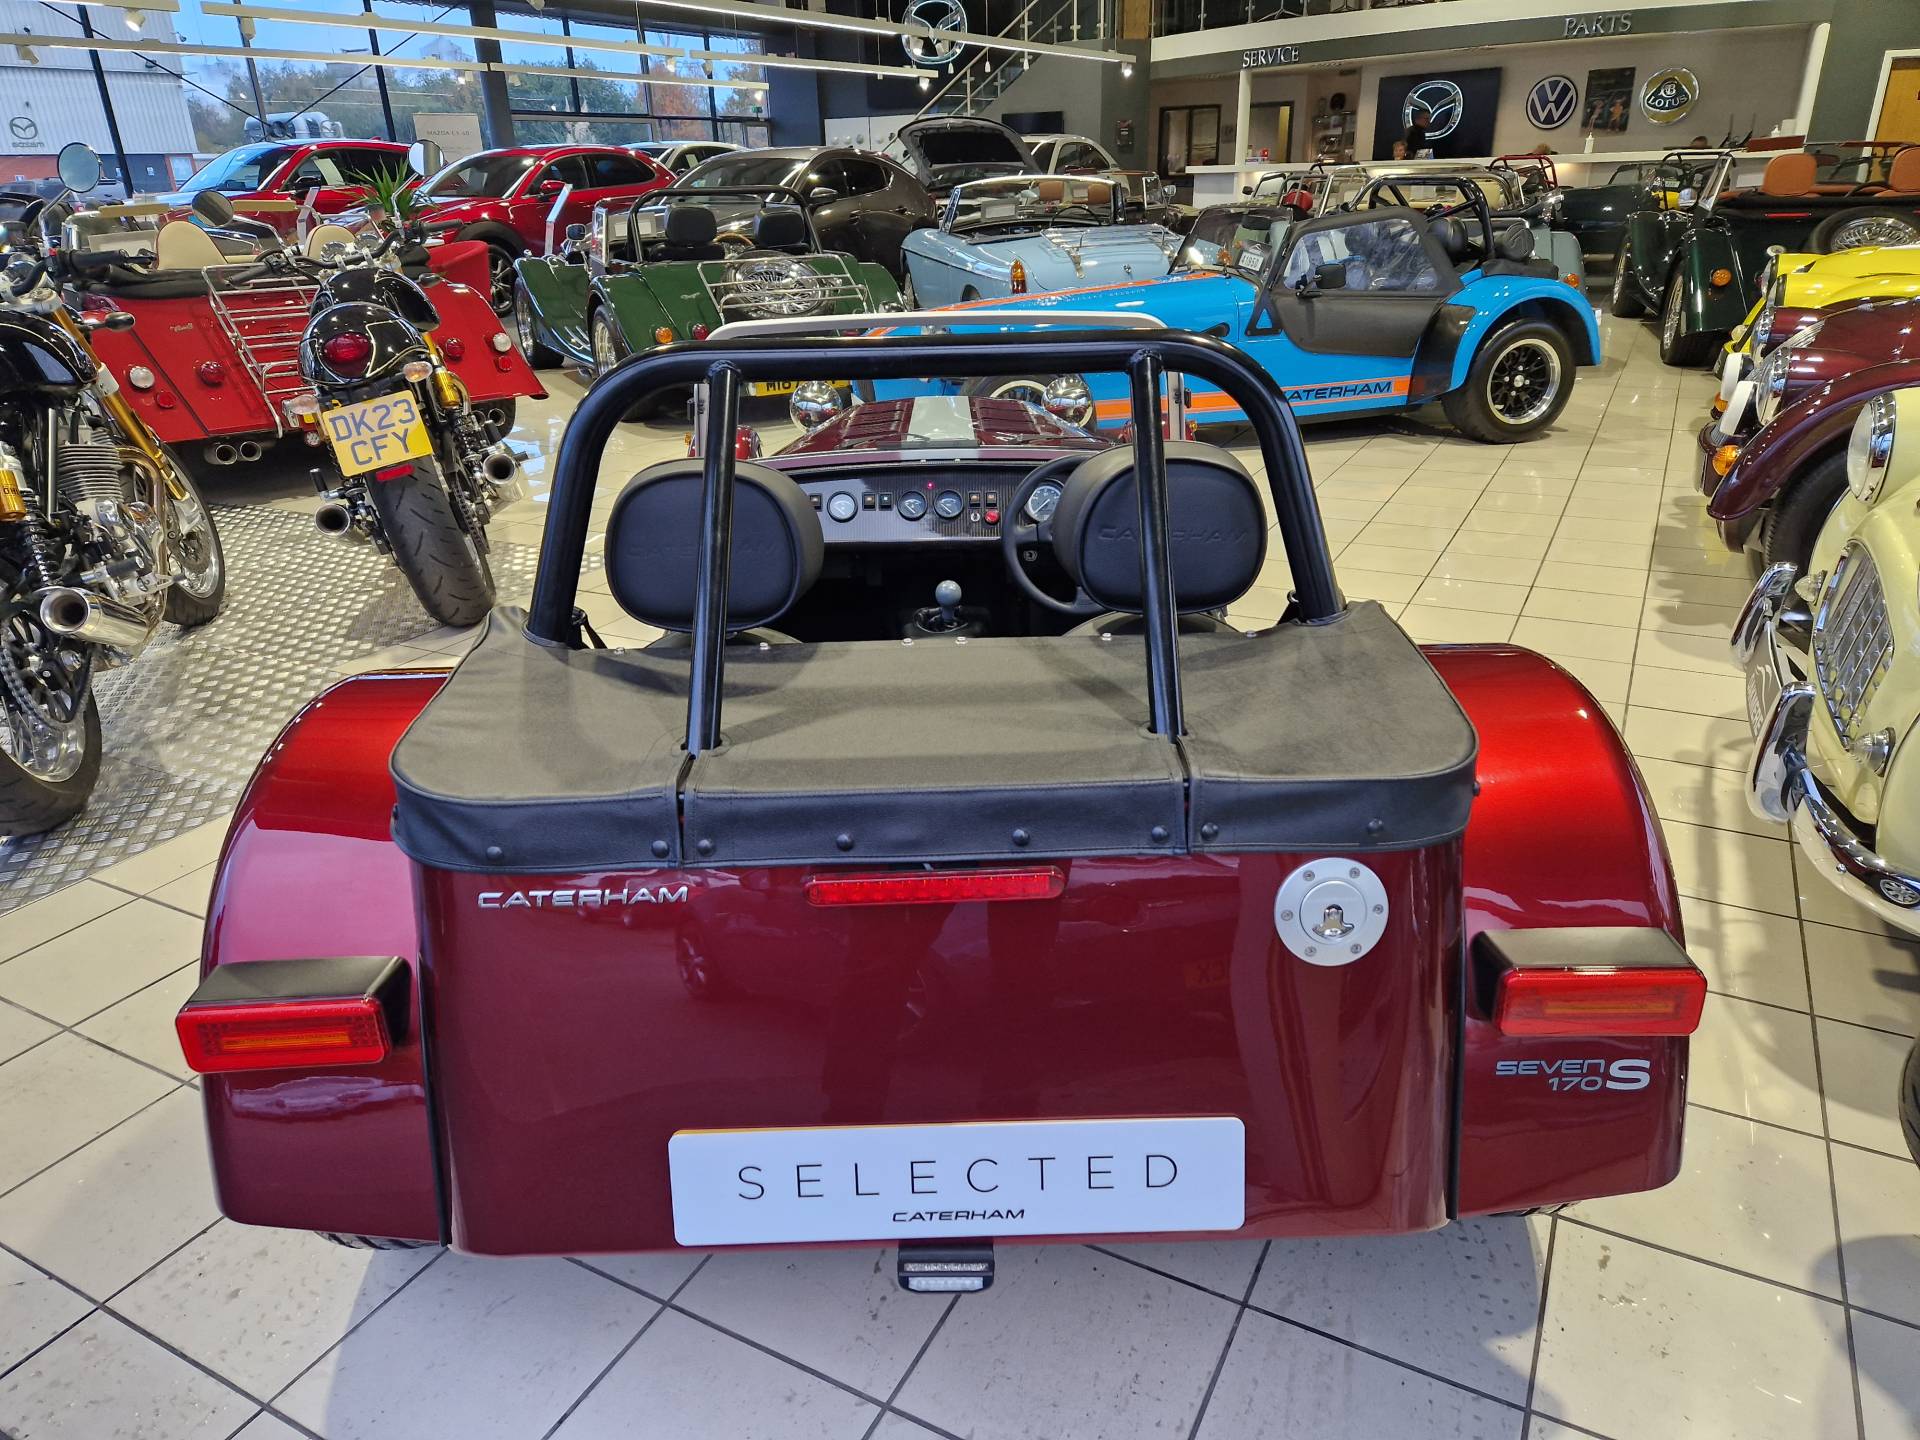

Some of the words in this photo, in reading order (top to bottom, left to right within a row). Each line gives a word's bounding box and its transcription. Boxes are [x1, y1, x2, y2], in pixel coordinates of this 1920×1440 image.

[1563, 12, 1632, 36] PARTS
[1242, 46, 1299, 68] SERVICE
[1648, 94, 1688, 107] LOTUS
[1284, 381, 1392, 401] ATERHAM
[329, 399, 416, 442] DK23
[350, 428, 410, 465] CFY
[477, 886, 689, 909] CATERHAM
[1495, 1059, 1605, 1075] SEVEN
[1549, 1076, 1603, 1091] 170
[738, 1154, 1178, 1200] SELECTED
[892, 1209, 1025, 1222] CATERHAM
